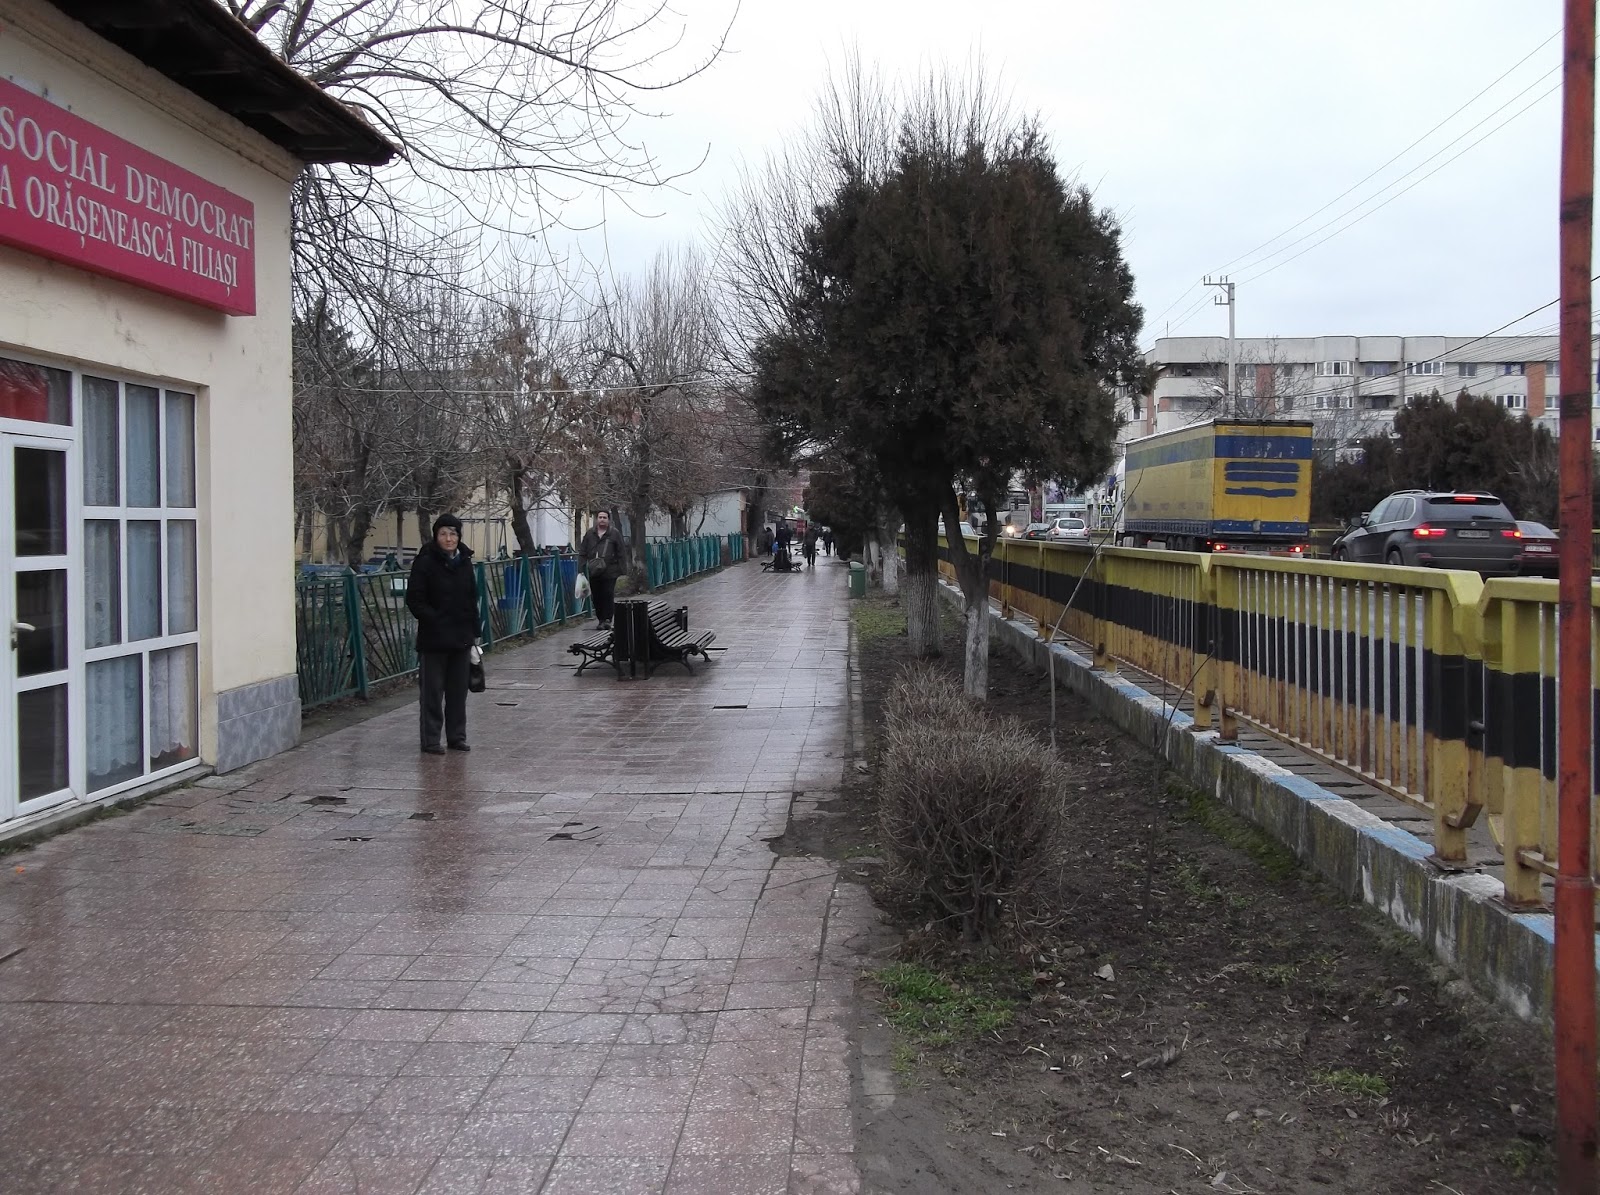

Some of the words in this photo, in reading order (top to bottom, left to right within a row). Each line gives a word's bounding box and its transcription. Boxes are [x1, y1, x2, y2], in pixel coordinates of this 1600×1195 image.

[0, 106, 116, 194] SOCIAL
[125, 164, 253, 250] DEMOCRAT
[181, 236, 238, 297] FILIAȘI
